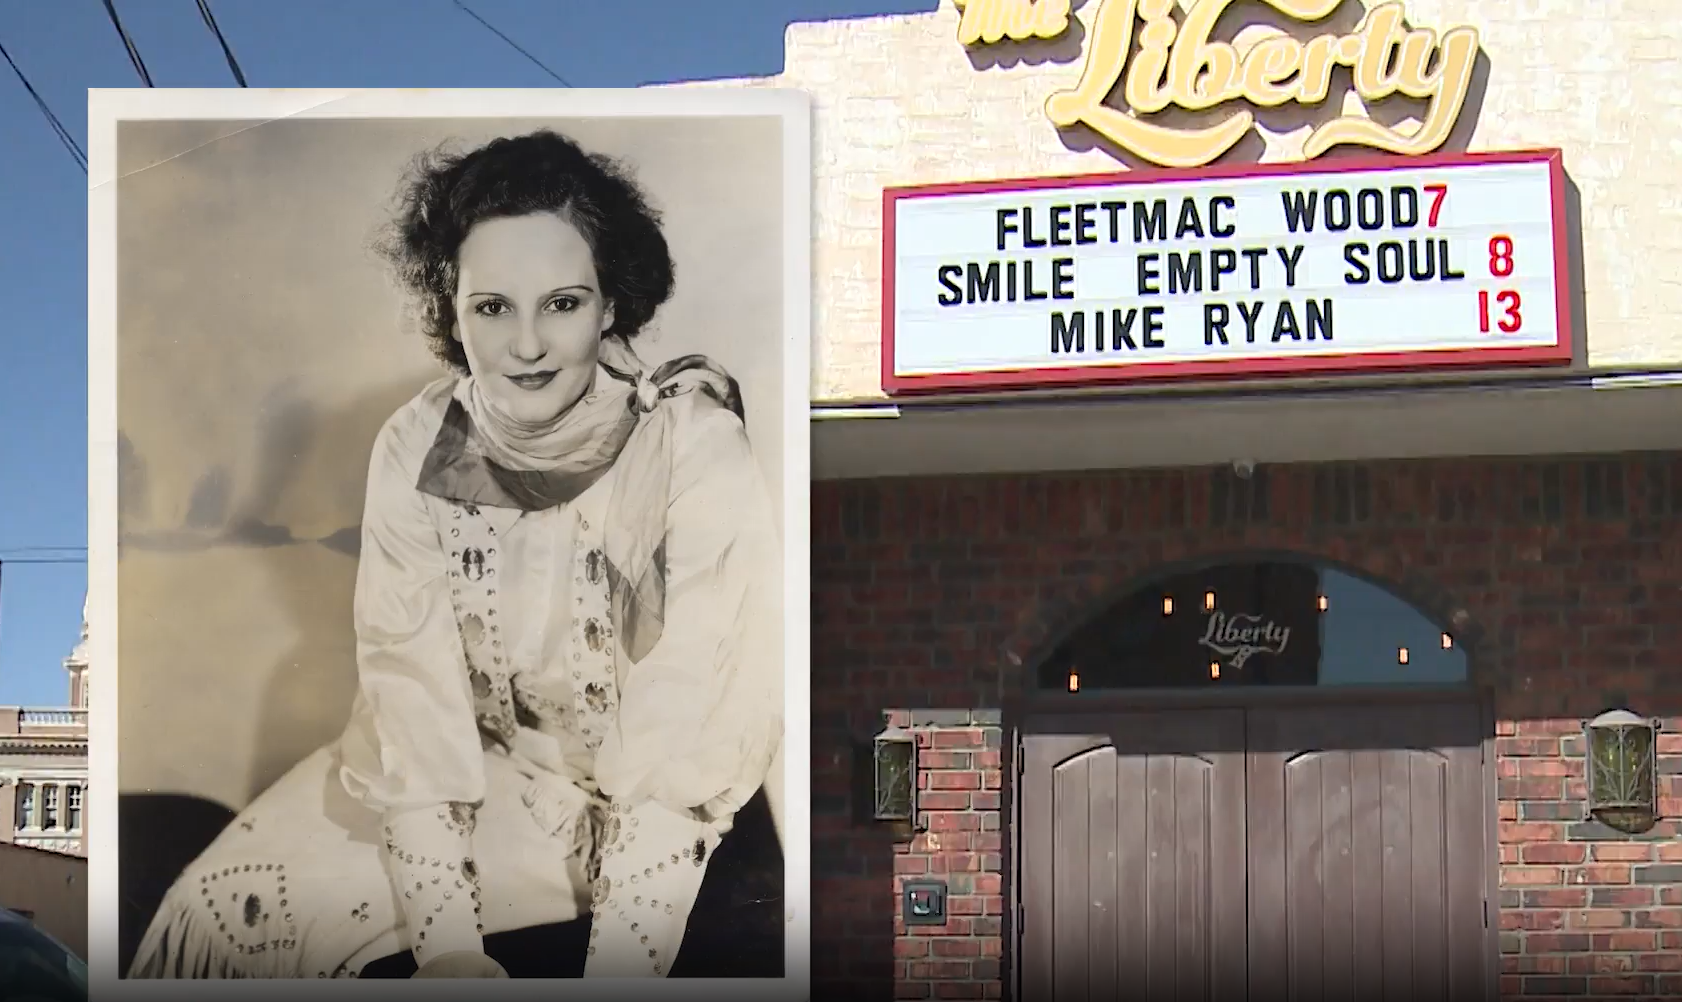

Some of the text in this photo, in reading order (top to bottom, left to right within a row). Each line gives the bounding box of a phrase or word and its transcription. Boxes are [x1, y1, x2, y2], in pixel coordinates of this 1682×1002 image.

[1044, 0, 1479, 169] Liberty
[996, 196, 1236, 251] FLEETMAC
[937, 235, 1514, 306] SMILE EMPTY SOUL 8
[1050, 289, 1522, 354] MIKE RYAN 13
[1198, 611, 1290, 655] Liberty
